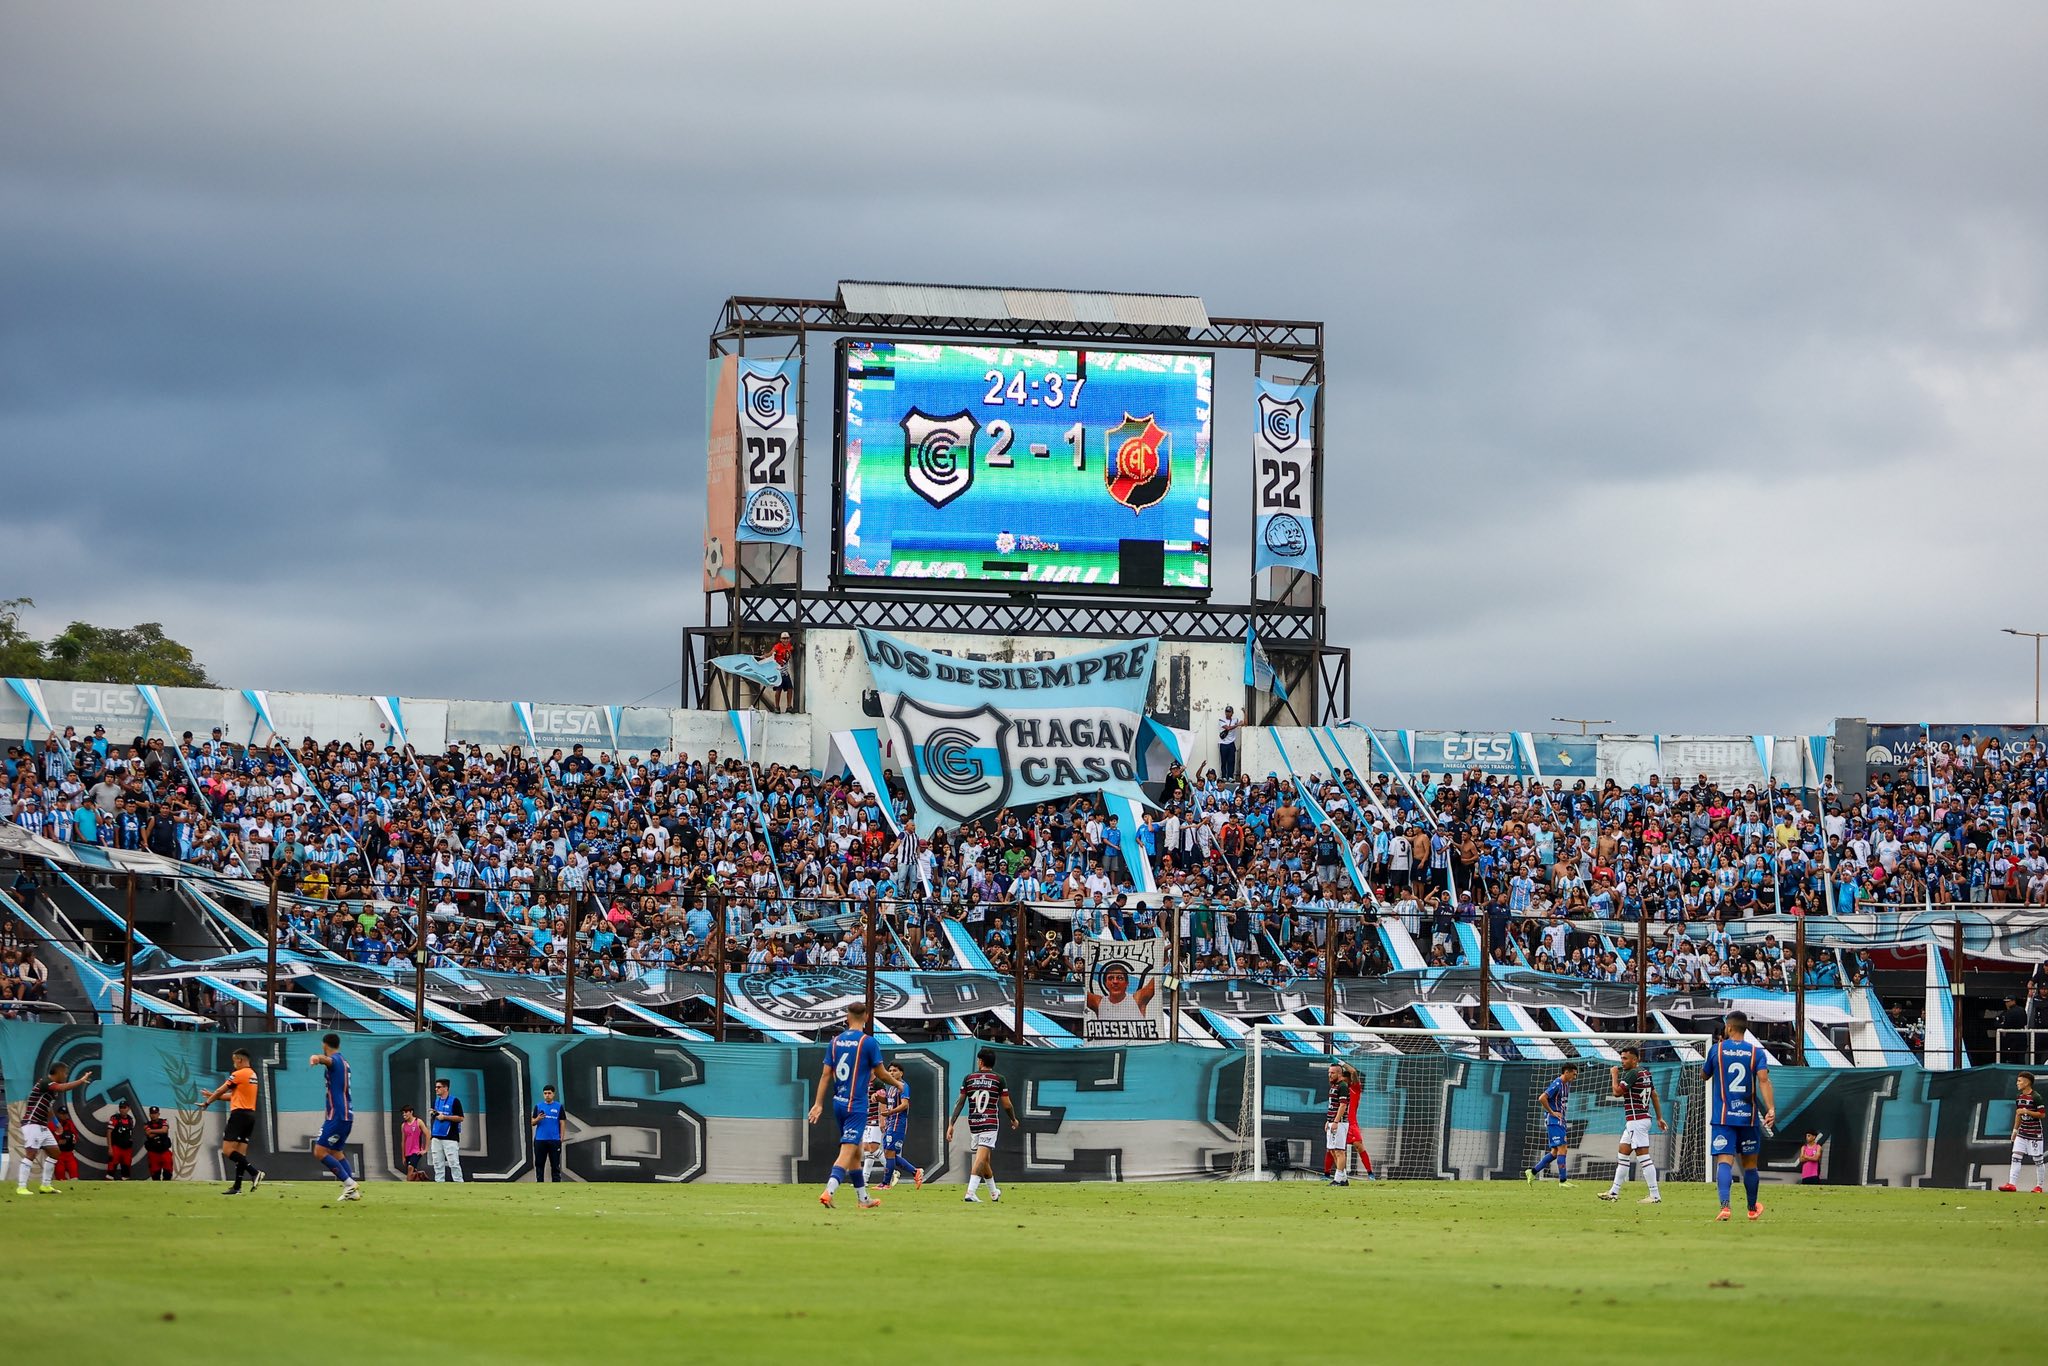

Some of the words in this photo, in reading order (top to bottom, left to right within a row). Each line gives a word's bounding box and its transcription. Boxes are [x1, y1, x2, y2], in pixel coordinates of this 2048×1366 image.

[983, 369, 1085, 408] 24:37
[985, 420, 1014, 468] 2
[1064, 422, 1086, 471] 1
[747, 437, 787, 484] 22
[1263, 459, 1301, 509] 22
[756, 508, 784, 521] LDS
[859, 629, 930, 679] LOS
[937, 664, 975, 684] DE
[978, 642, 1149, 690] SIEMPRE
[521, 709, 602, 735] JESA
[1894, 740, 1952, 755] MARO
[1020, 757, 1135, 787] CASO
[1400, 840, 1406, 852] 3
[1087, 940, 1156, 966] FRULA
[1087, 1020, 1159, 1040] PRESENTE
[836, 1053, 850, 1081] 6
[1728, 1062, 1746, 1092] 2
[215, 1036, 708, 1183] LOS
[971, 1090, 990, 1114] 10
[1639, 1087, 1652, 1109] 17
